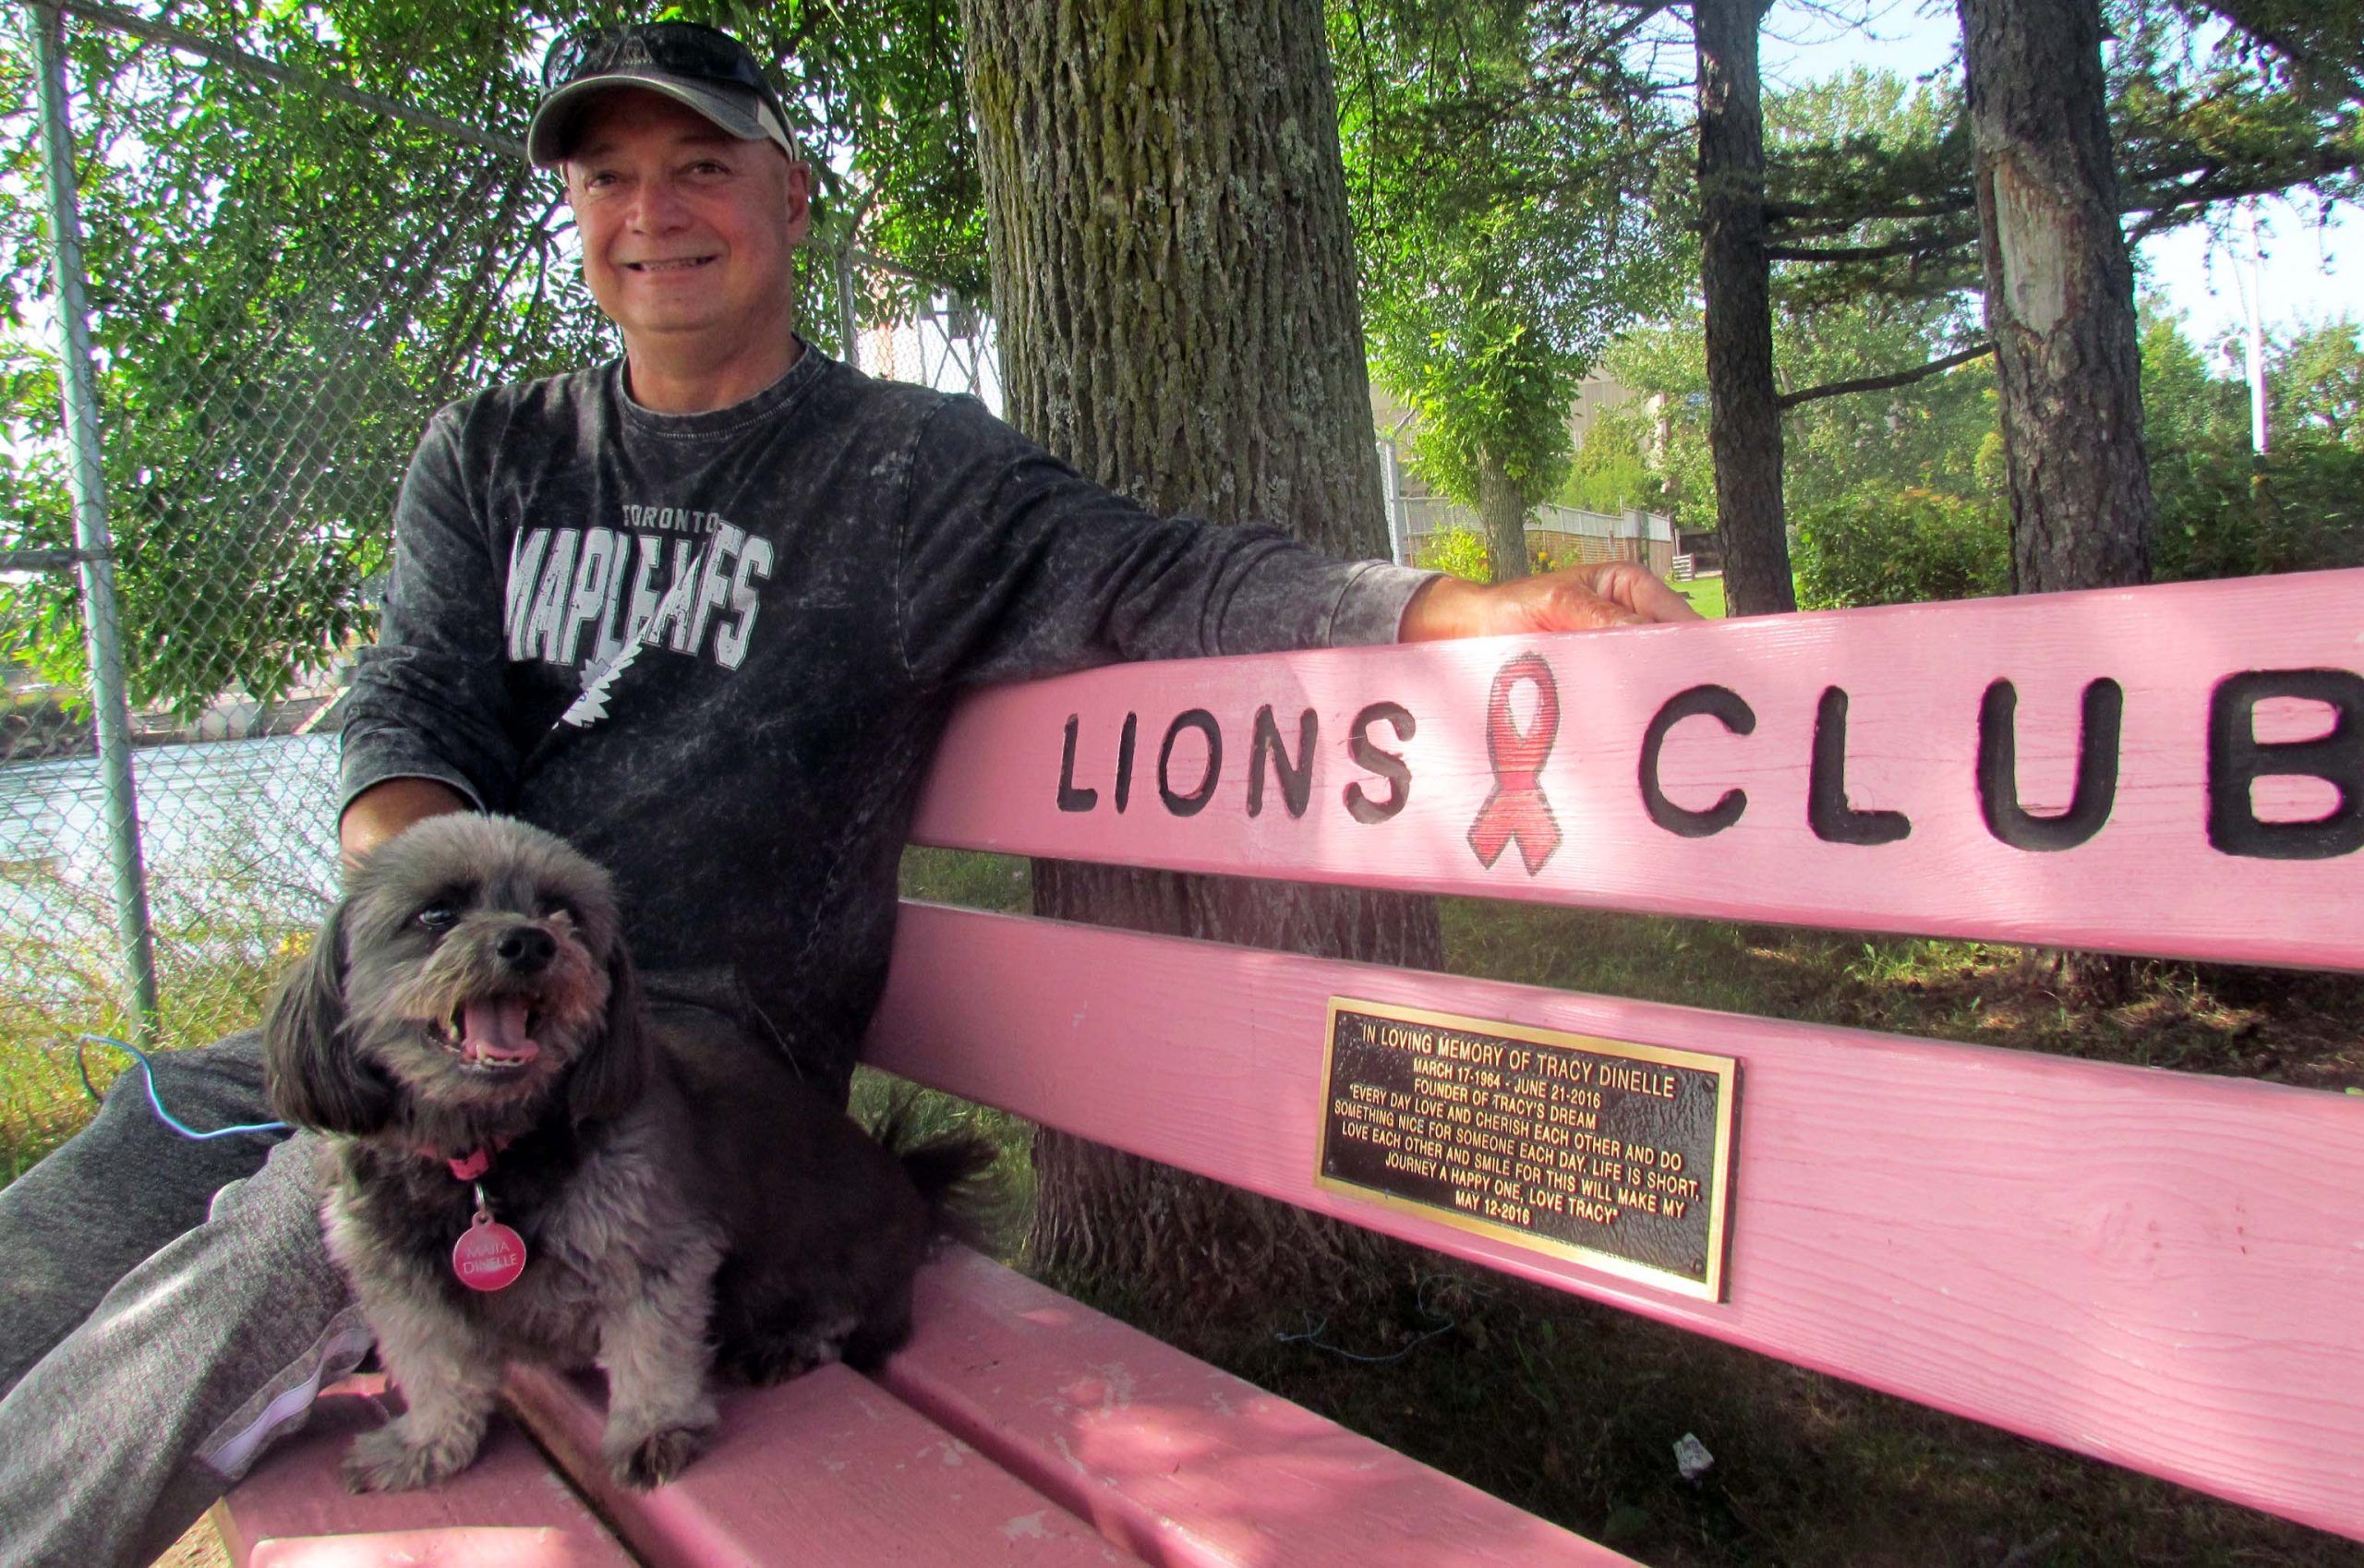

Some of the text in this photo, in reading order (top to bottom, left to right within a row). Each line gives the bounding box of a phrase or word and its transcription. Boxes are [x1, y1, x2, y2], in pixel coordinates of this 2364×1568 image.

[621, 504, 720, 535] TORONTO
[1056, 666, 2364, 861] LIONS CLUB
[1363, 1023, 1675, 1098] IN LOVING MEMORY OF TRACY DINELLE
[1413, 1057, 1453, 1080] MARCH
[1514, 1078, 1548, 1099] JUNE
[1551, 1084, 1601, 1109] 21-2016
[1390, 1092, 1411, 1111] DAY
[1415, 1098, 1444, 1118] LOVE
[1447, 1105, 1471, 1124] AND
[1476, 1111, 1529, 1138] CHERISH
[1534, 1124, 1569, 1147] EACH
[1574, 1132, 1621, 1158] OTHER
[1625, 1144, 1654, 1164] AND
[1661, 1151, 1682, 1171] DO
[1414, 1078, 1597, 1130] FOUNDER OF TRACY'S DREAM
[1334, 1099, 1393, 1128] SOMETHING
[1399, 1116, 1424, 1135] NICE
[1429, 1122, 1452, 1141] FOR
[1456, 1128, 1514, 1156] SOMEONE
[1520, 1143, 1553, 1166] EACH
[1592, 1159, 1622, 1181] LIFE
[1628, 1166, 1641, 1186] IS
[1647, 1171, 1700, 1201] SHORT,
[1342, 1121, 1685, 1220] LOVE EACH OTHER AND SMILE FOR THIS WILL MAKE MY
[1385, 1152, 1437, 1178] JOURNEY
[1439, 1165, 1448, 1182] A
[1451, 1168, 1490, 1191] HAPPY
[1529, 1188, 1563, 1212] LOVE
[1455, 1190, 1531, 1225] MAY 12-2016
